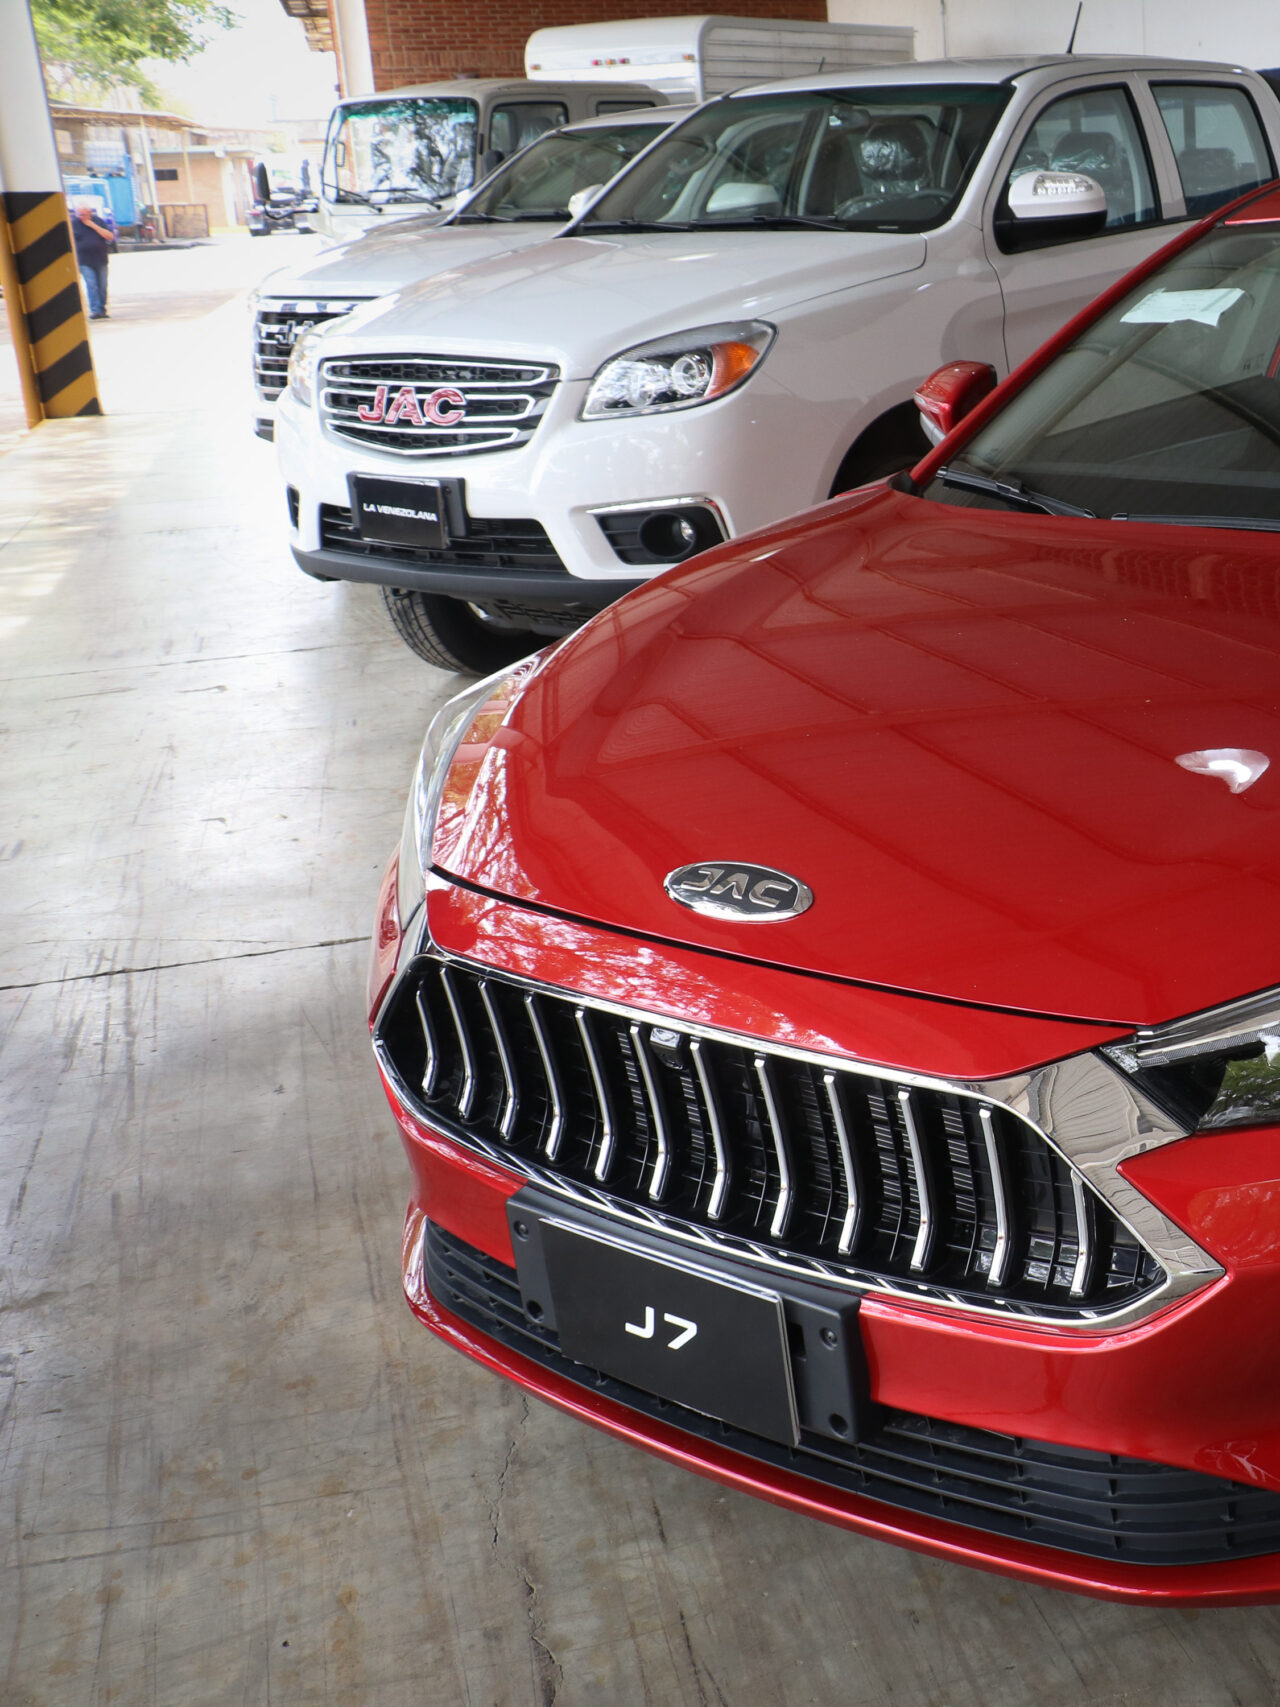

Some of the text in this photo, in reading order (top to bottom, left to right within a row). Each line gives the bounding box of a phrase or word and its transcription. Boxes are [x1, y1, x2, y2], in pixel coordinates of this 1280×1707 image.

[358, 385, 466, 427] JAC
[363, 502, 439, 522] LA VENEZOLANA
[680, 867, 793, 908] JAC
[624, 1305, 698, 1351] J7
